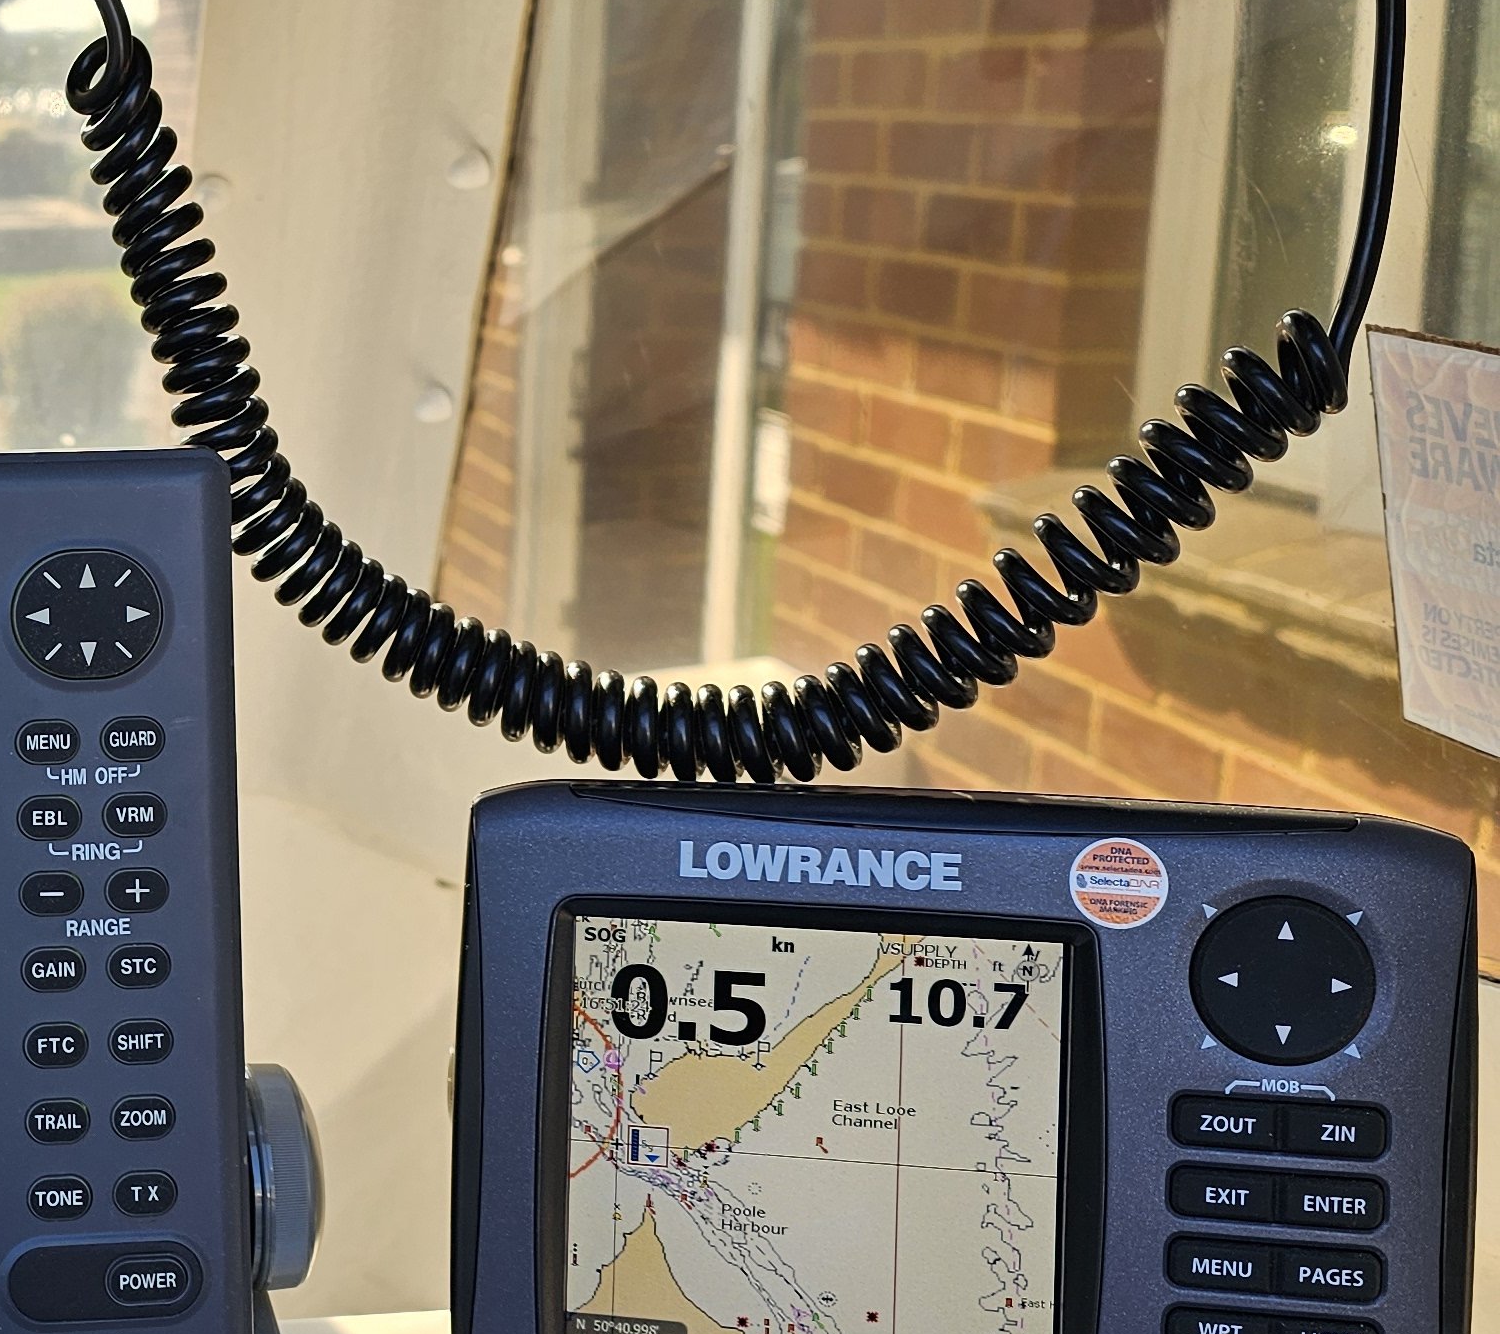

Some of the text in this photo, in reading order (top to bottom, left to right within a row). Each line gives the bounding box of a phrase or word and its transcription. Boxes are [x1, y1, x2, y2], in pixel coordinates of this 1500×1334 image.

[26, 734, 71, 751] MENU
[109, 729, 157, 747] GUARD
[60, 767, 129, 786] HM OFF
[32, 811, 68, 826] EBL
[116, 806, 154, 824] VRM
[71, 843, 122, 861] RING
[1093, 854, 1149, 864] PROTECTED
[1111, 847, 1132, 855] DNA
[679, 840, 963, 891] LOWRANCE
[65, 919, 131, 937] RANGE
[585, 927, 794, 953] SOG kn
[880, 942, 957, 958] VSUPPLY
[31, 962, 76, 978] GAIN
[120, 958, 157, 974] STC
[925, 958, 966, 969] DEPTH
[611, 964, 766, 1047] 0.5
[889, 978, 1029, 1029] 10.7
[37, 1038, 75, 1054] FTC
[116, 1033, 164, 1051] SHIFT
[1261, 1078, 1300, 1094] MOB
[833, 1099, 870, 1115] East
[34, 1114, 81, 1131] TRAIL
[119, 1110, 167, 1126] ZOOM
[831, 1114, 899, 1130] Channel
[1200, 1115, 1256, 1134] ZOUT
[1321, 1124, 1357, 1143] ZIN
[35, 1190, 83, 1208] TONE
[1205, 1188, 1249, 1206] EXIT
[1303, 1195, 1367, 1215] ENTER
[722, 1203, 766, 1218] Poole
[722, 1218, 788, 1235] Harbour
[1192, 1258, 1253, 1277] MENU
[119, 1272, 176, 1290] POWER
[1299, 1267, 1364, 1287] PAGES
[576, 1318, 586, 1329] N
